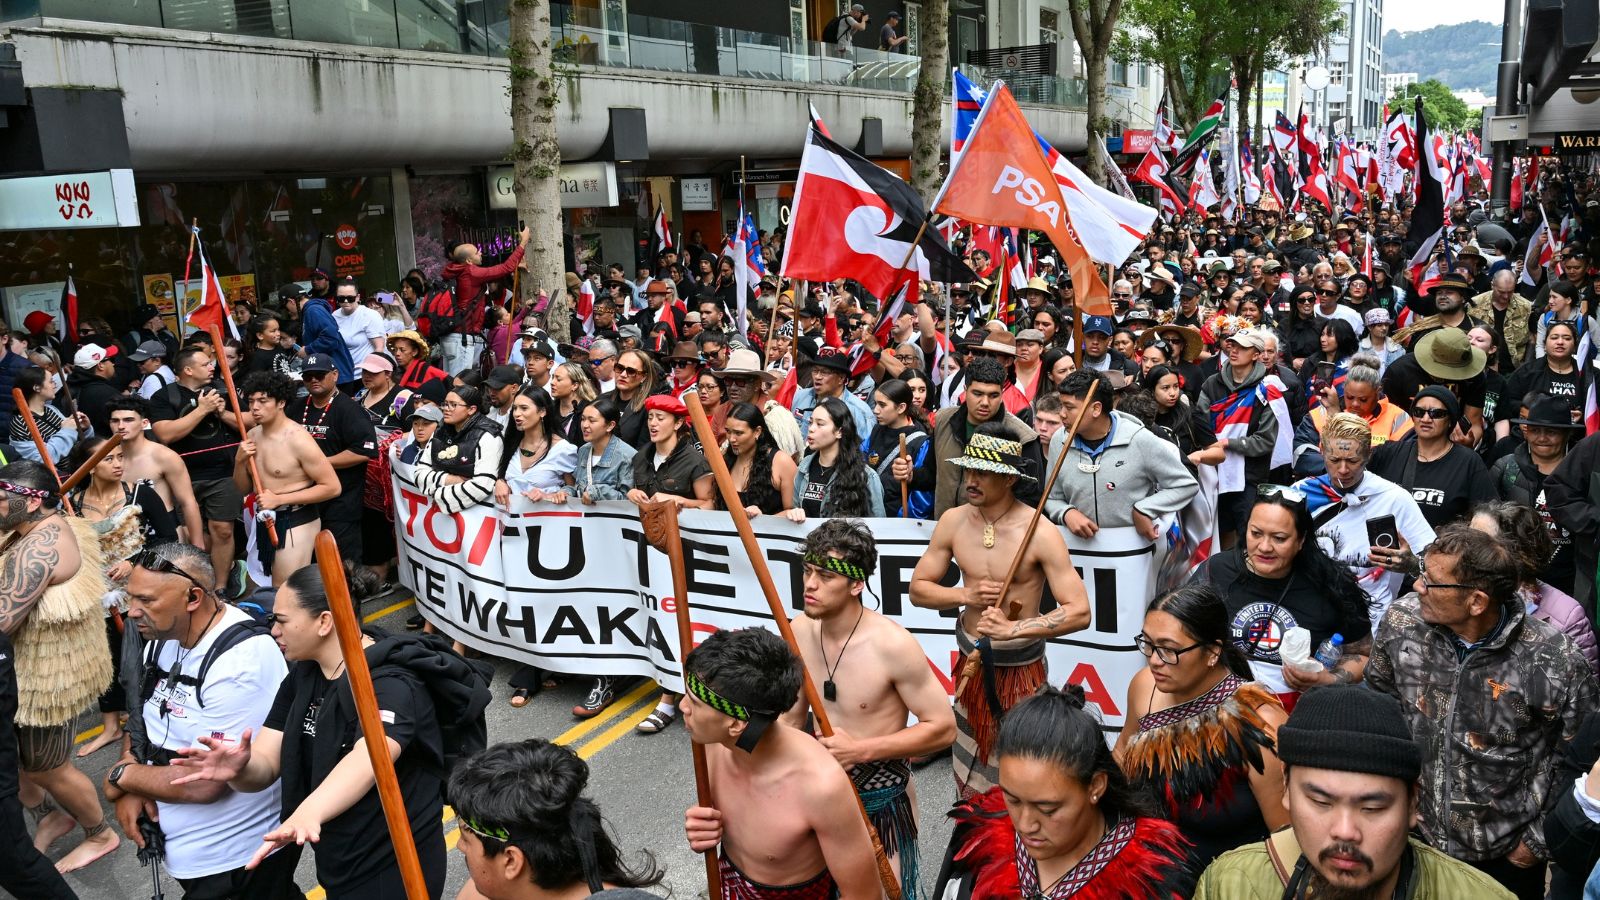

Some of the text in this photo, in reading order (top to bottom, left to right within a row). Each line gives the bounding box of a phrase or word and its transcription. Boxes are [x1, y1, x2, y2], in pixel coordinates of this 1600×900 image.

[55, 181, 90, 203] KOKO
[991, 164, 1060, 229] PSA
[335, 254, 364, 267] OPEN
[1412, 489, 1446, 505] ori
[621, 527, 736, 599] TE
[407, 555, 447, 610] TE
[640, 589, 678, 613] me
[1238, 604, 1264, 622] UNITED
